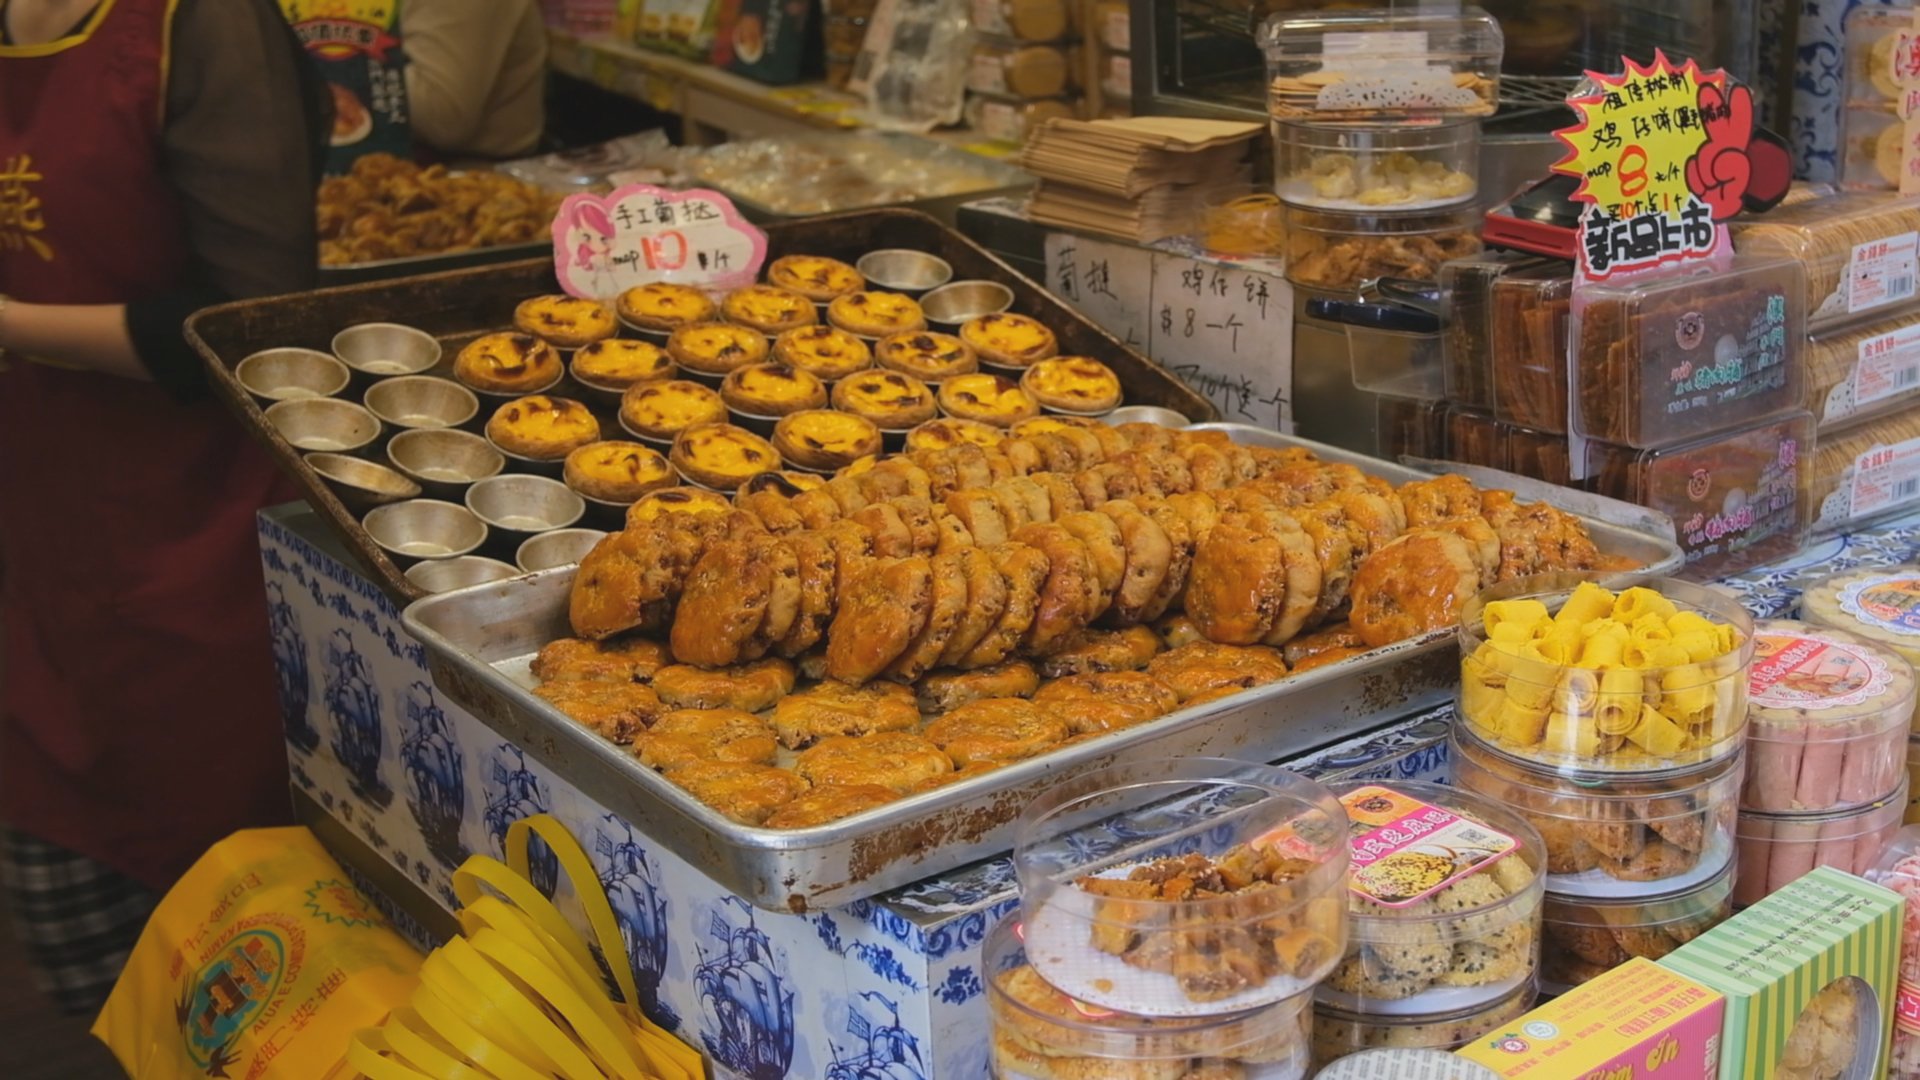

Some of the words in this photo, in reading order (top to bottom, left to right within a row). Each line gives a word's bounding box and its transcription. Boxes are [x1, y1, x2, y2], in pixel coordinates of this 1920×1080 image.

[1617, 144, 1648, 197] 8
[641, 230, 688, 270] 10
[1585, 198, 1713, 271] 新品上市
